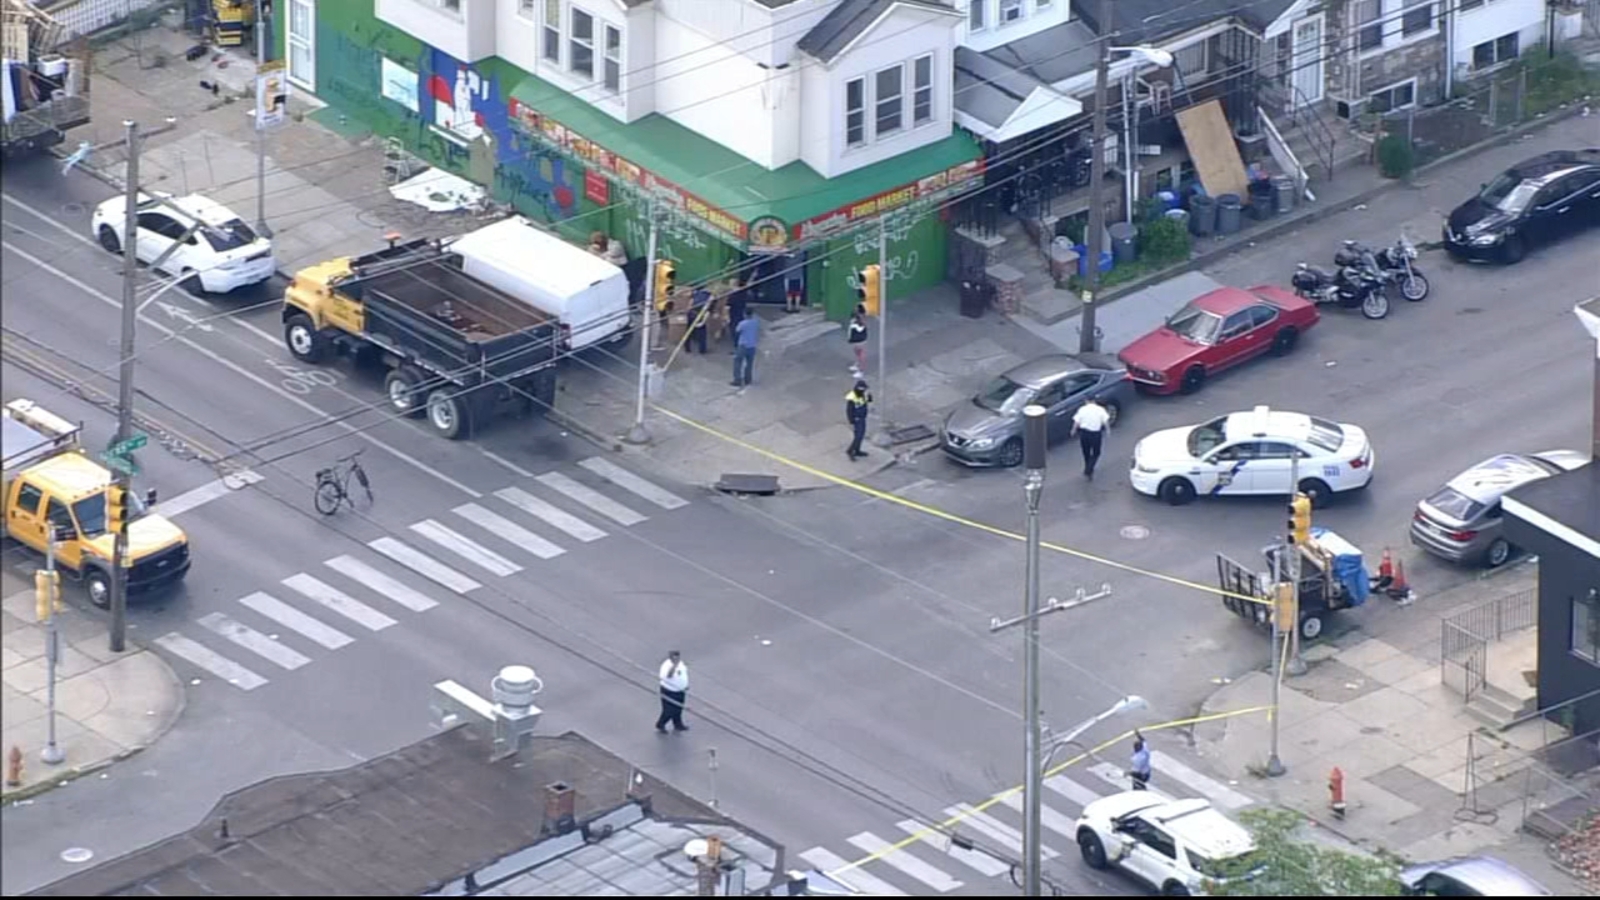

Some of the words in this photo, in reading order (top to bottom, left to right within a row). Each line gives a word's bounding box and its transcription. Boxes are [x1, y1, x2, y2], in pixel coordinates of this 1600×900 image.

[686, 197, 708, 218] FOOD
[708, 210, 740, 238] MARKET
[851, 200, 877, 219] FOOD
[877, 184, 917, 211] MARKET
